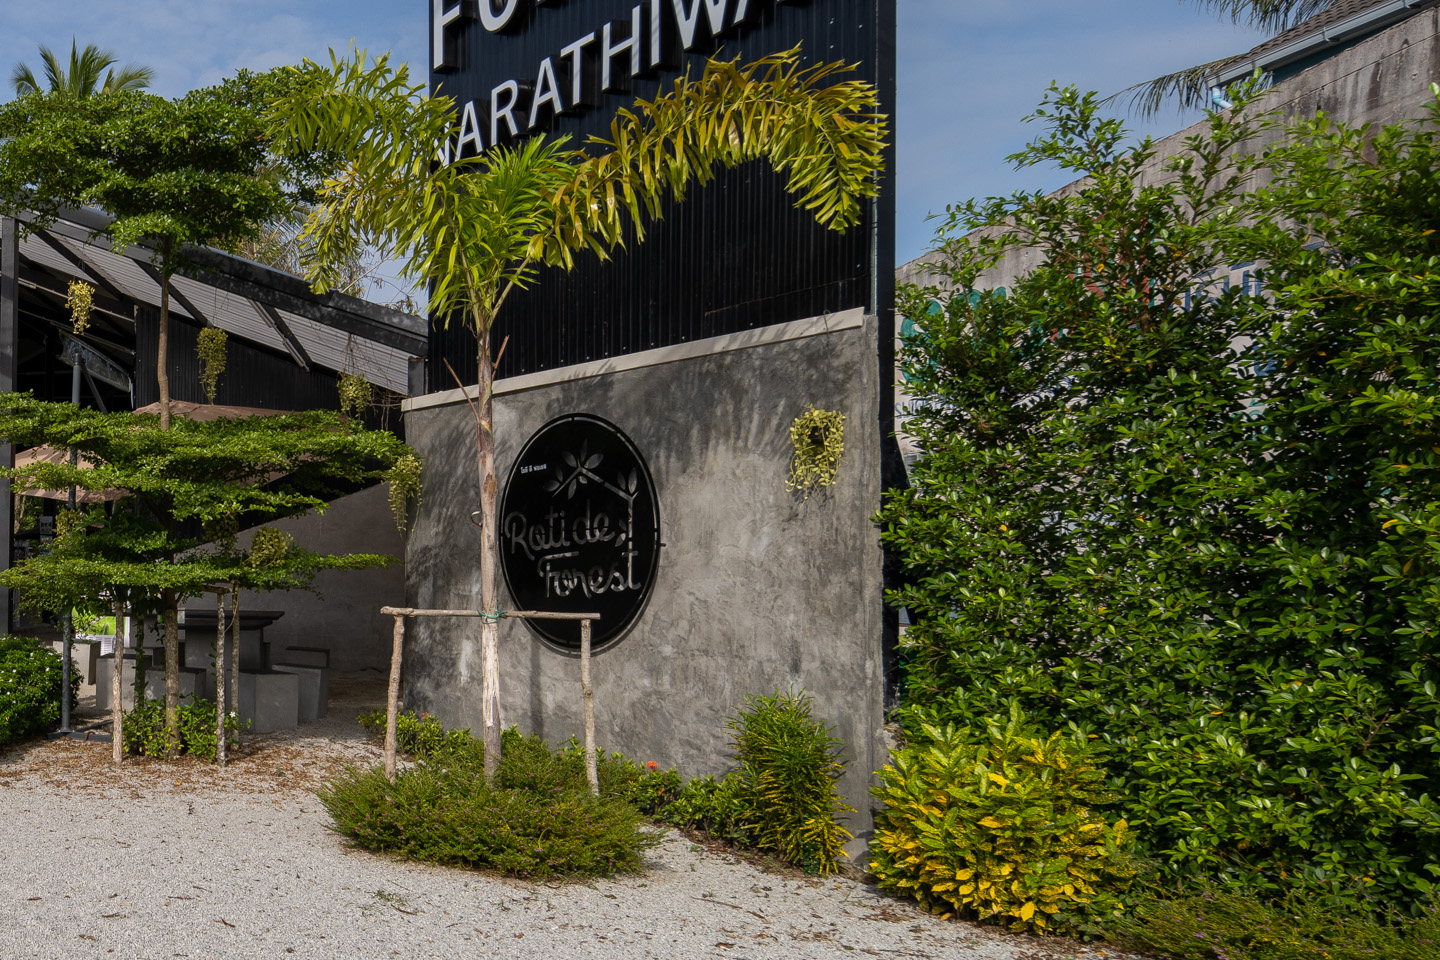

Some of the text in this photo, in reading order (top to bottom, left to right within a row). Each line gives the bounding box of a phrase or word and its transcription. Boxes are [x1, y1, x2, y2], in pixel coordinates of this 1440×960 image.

[504, 498, 616, 561] Roti de
[537, 540, 642, 599] Forest
